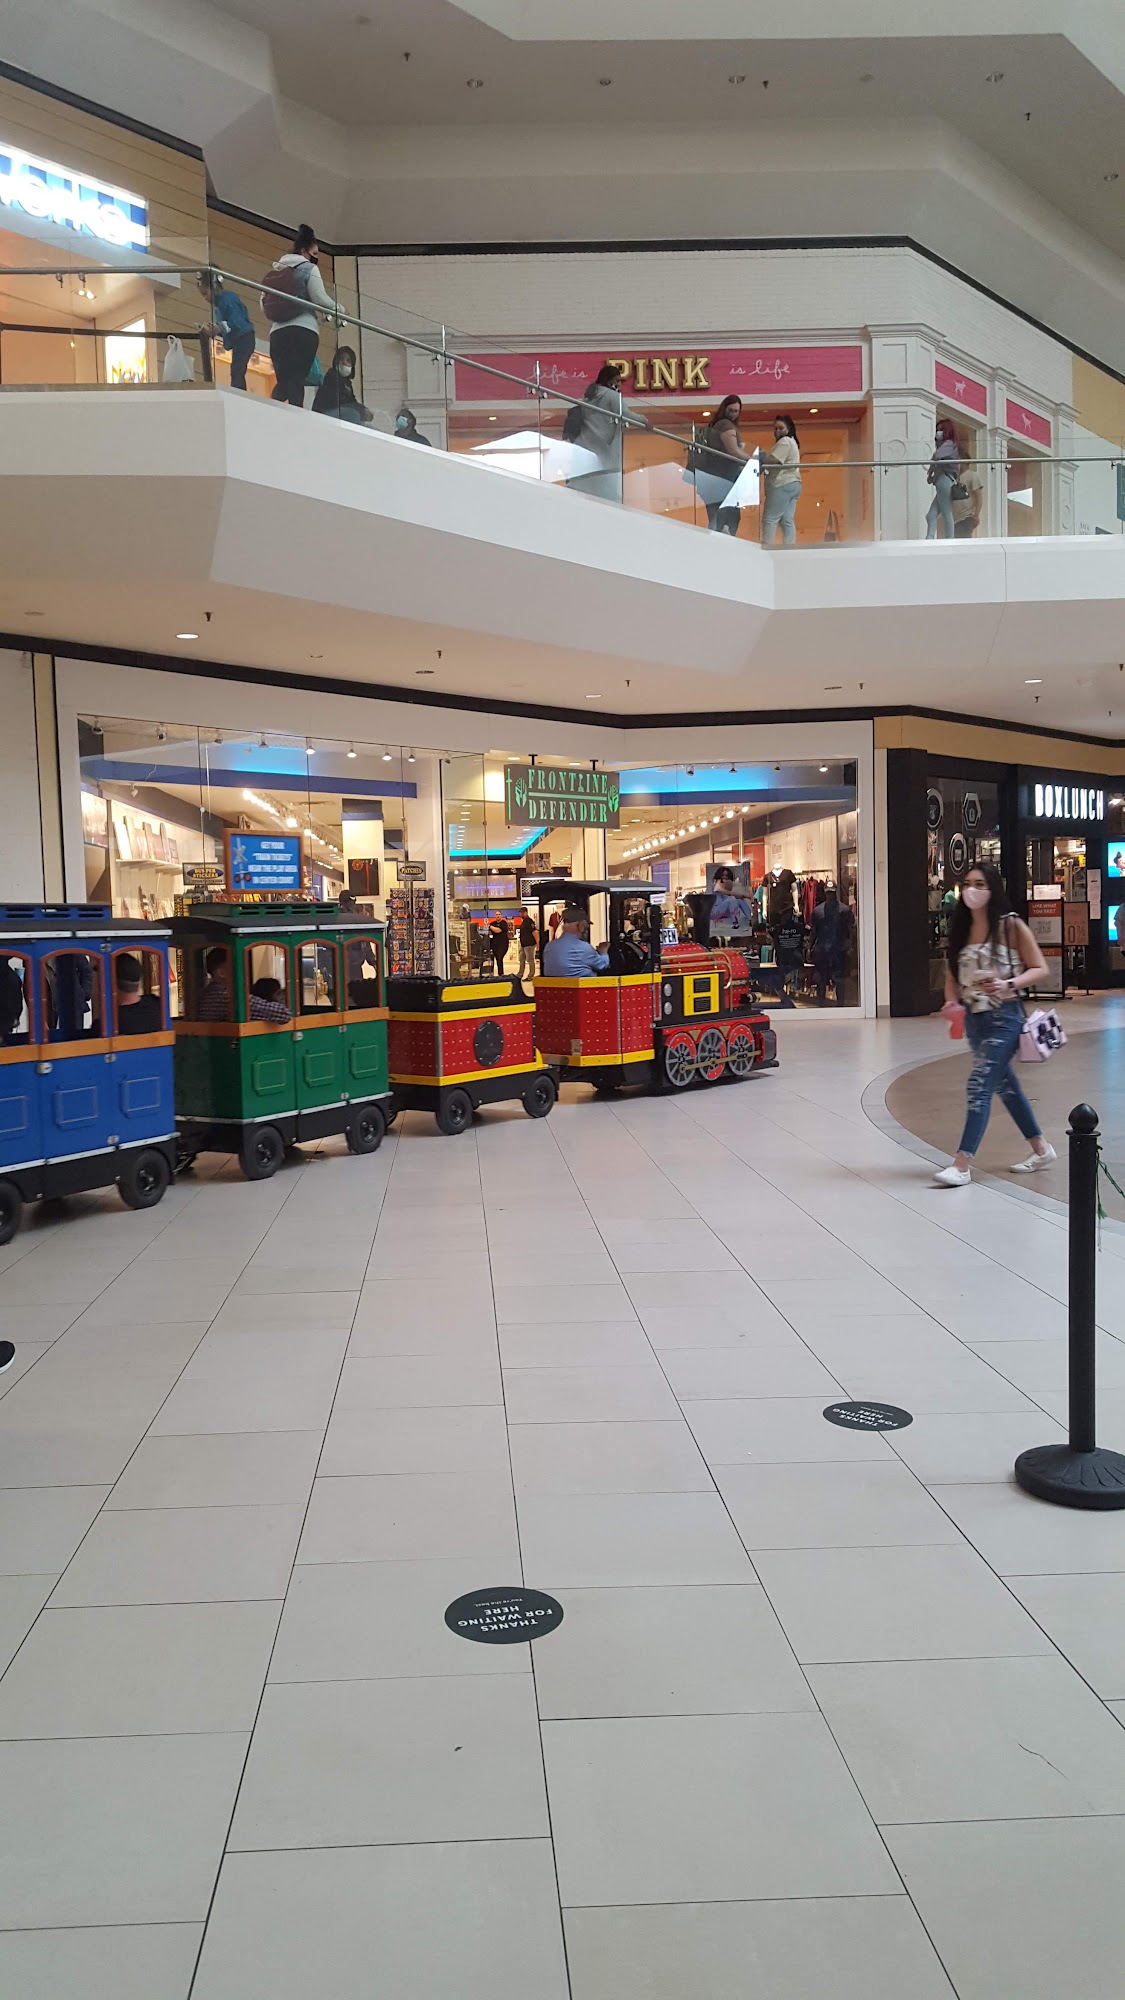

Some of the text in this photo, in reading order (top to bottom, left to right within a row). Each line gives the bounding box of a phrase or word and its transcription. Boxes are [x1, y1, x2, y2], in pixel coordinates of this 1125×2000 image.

[526, 355, 791, 391] life is PINK is life
[1034, 783, 1104, 821] BOXLUNCH
[528, 799, 608, 823] DEFENDER
[832, 1408, 876, 1421] WAITING
[839, 1414, 878, 1427] THANKS
[878, 1419, 898, 1427] FOR
[457, 1608, 553, 1627] FOR WAITING
[483, 1605, 520, 1616] HERE
[480, 1618, 539, 1632] THANKS
